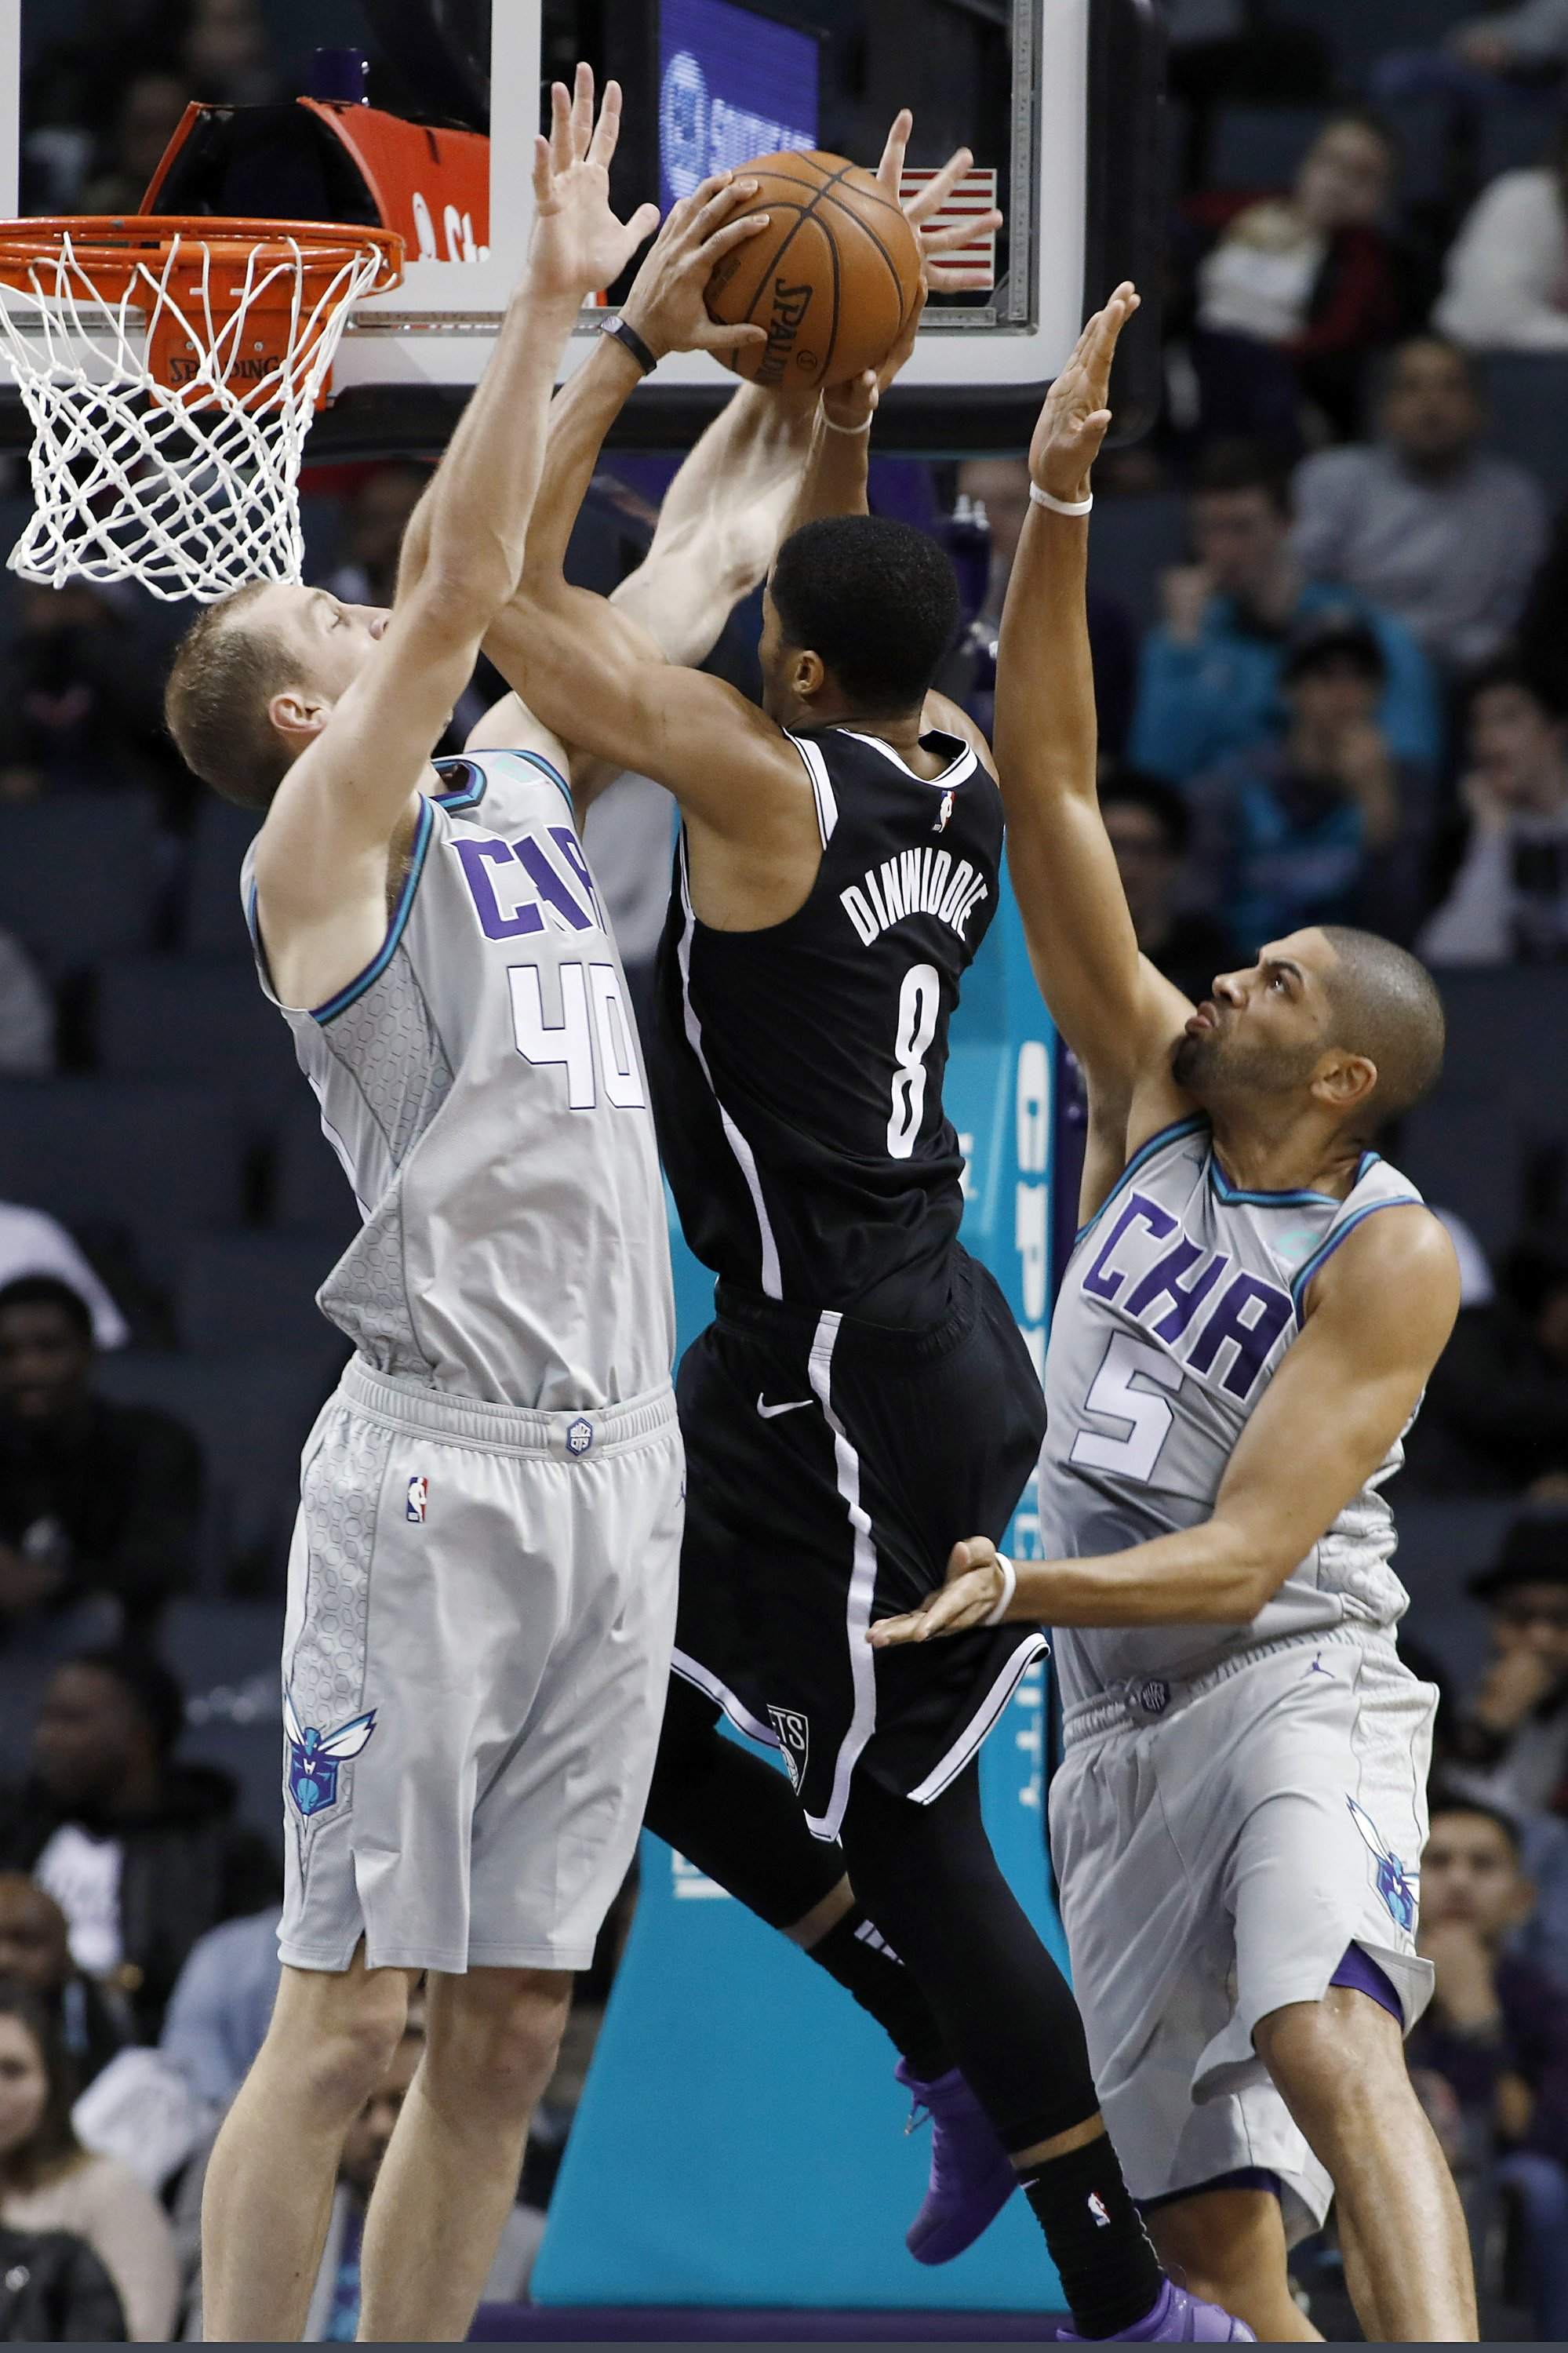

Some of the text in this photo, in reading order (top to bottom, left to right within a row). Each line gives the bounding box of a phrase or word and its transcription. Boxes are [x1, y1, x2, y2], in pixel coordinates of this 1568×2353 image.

[839, 846, 988, 947] DINWIDDIE
[507, 962, 646, 1110] 40
[886, 963, 940, 1159] 8
[1080, 1188, 1296, 1405] CHA
[1069, 1330, 1185, 1485] 5
